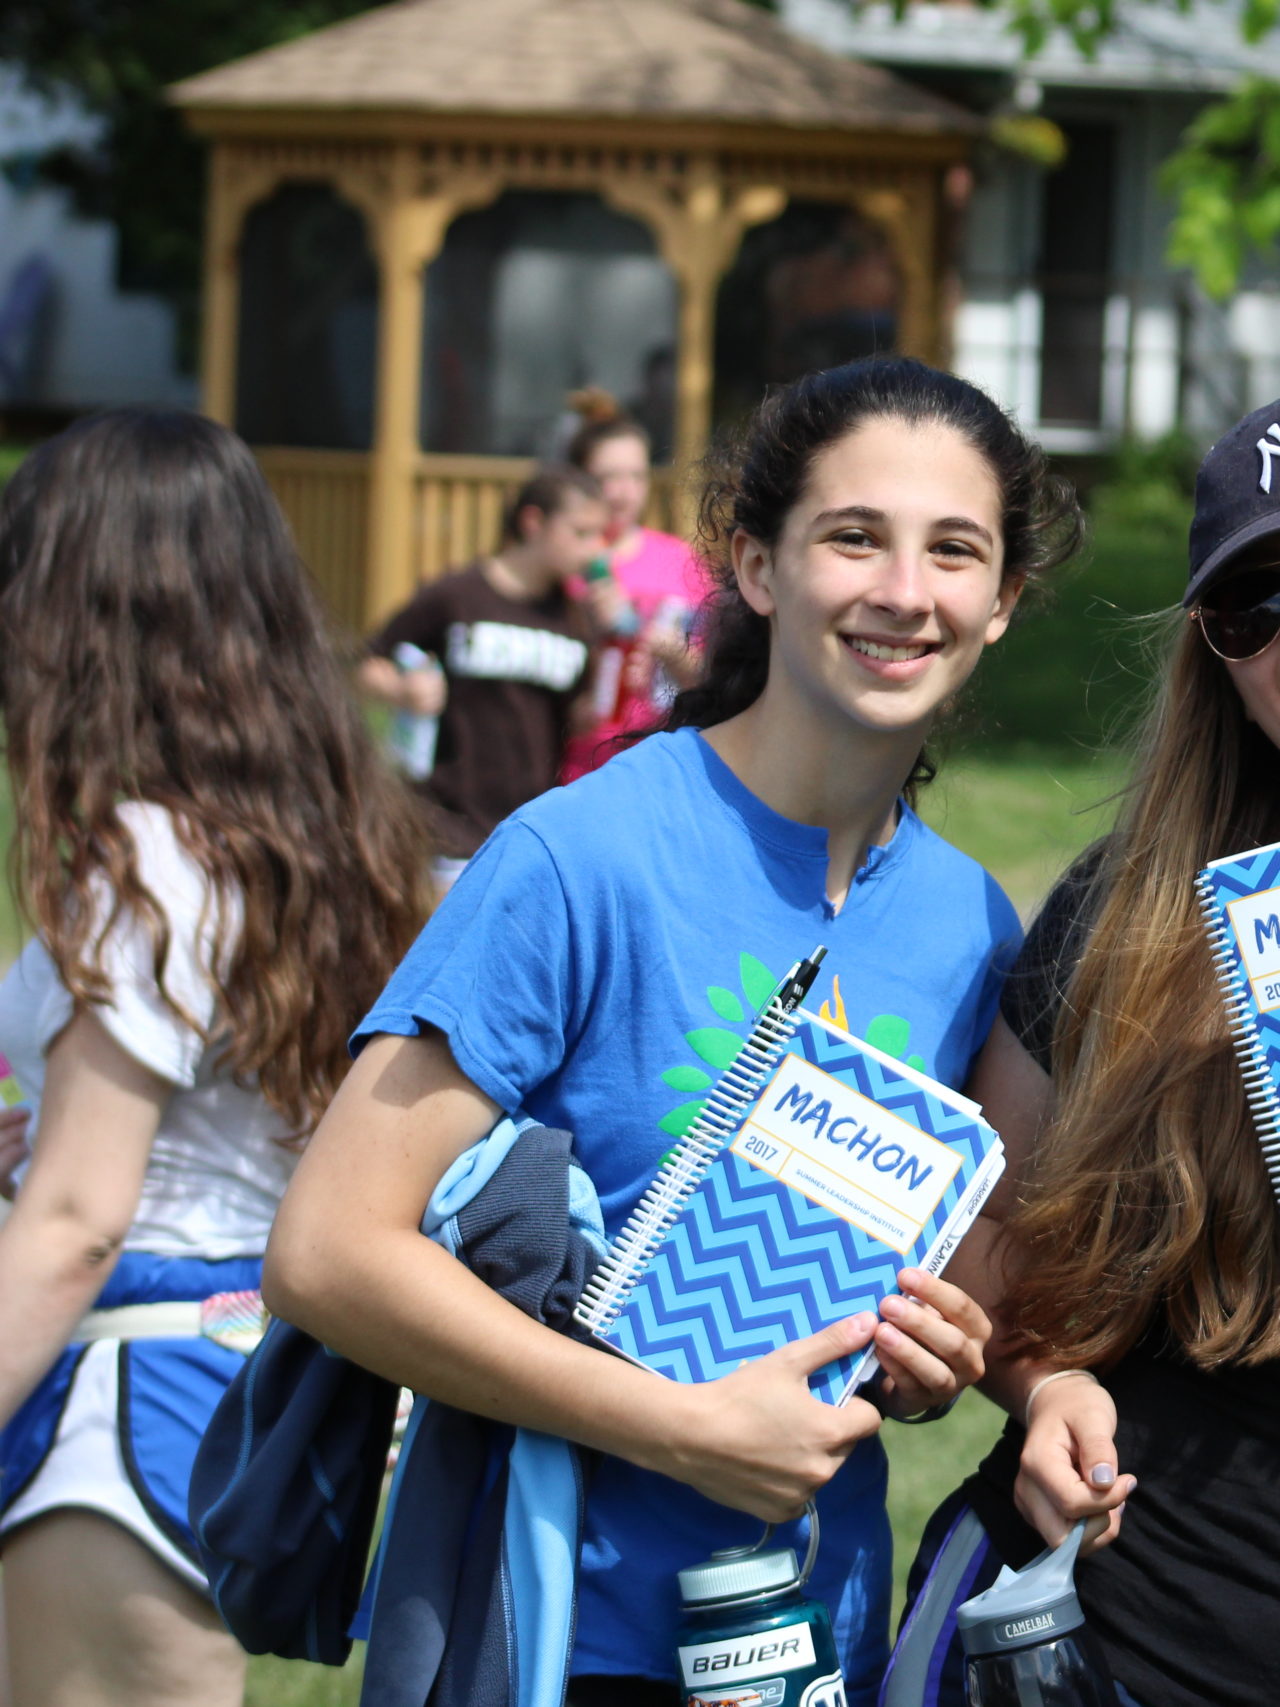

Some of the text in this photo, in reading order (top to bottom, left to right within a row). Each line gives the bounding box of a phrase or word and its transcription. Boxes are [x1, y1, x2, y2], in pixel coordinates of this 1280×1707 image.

[774, 1083, 934, 1190] MACHON
[744, 1135, 906, 1239] 2017 SUMMER LEADERSHIP INSTITUTE
[928, 1239, 953, 1275] PLANN
[1004, 1612, 1056, 1638] CAMELBAK
